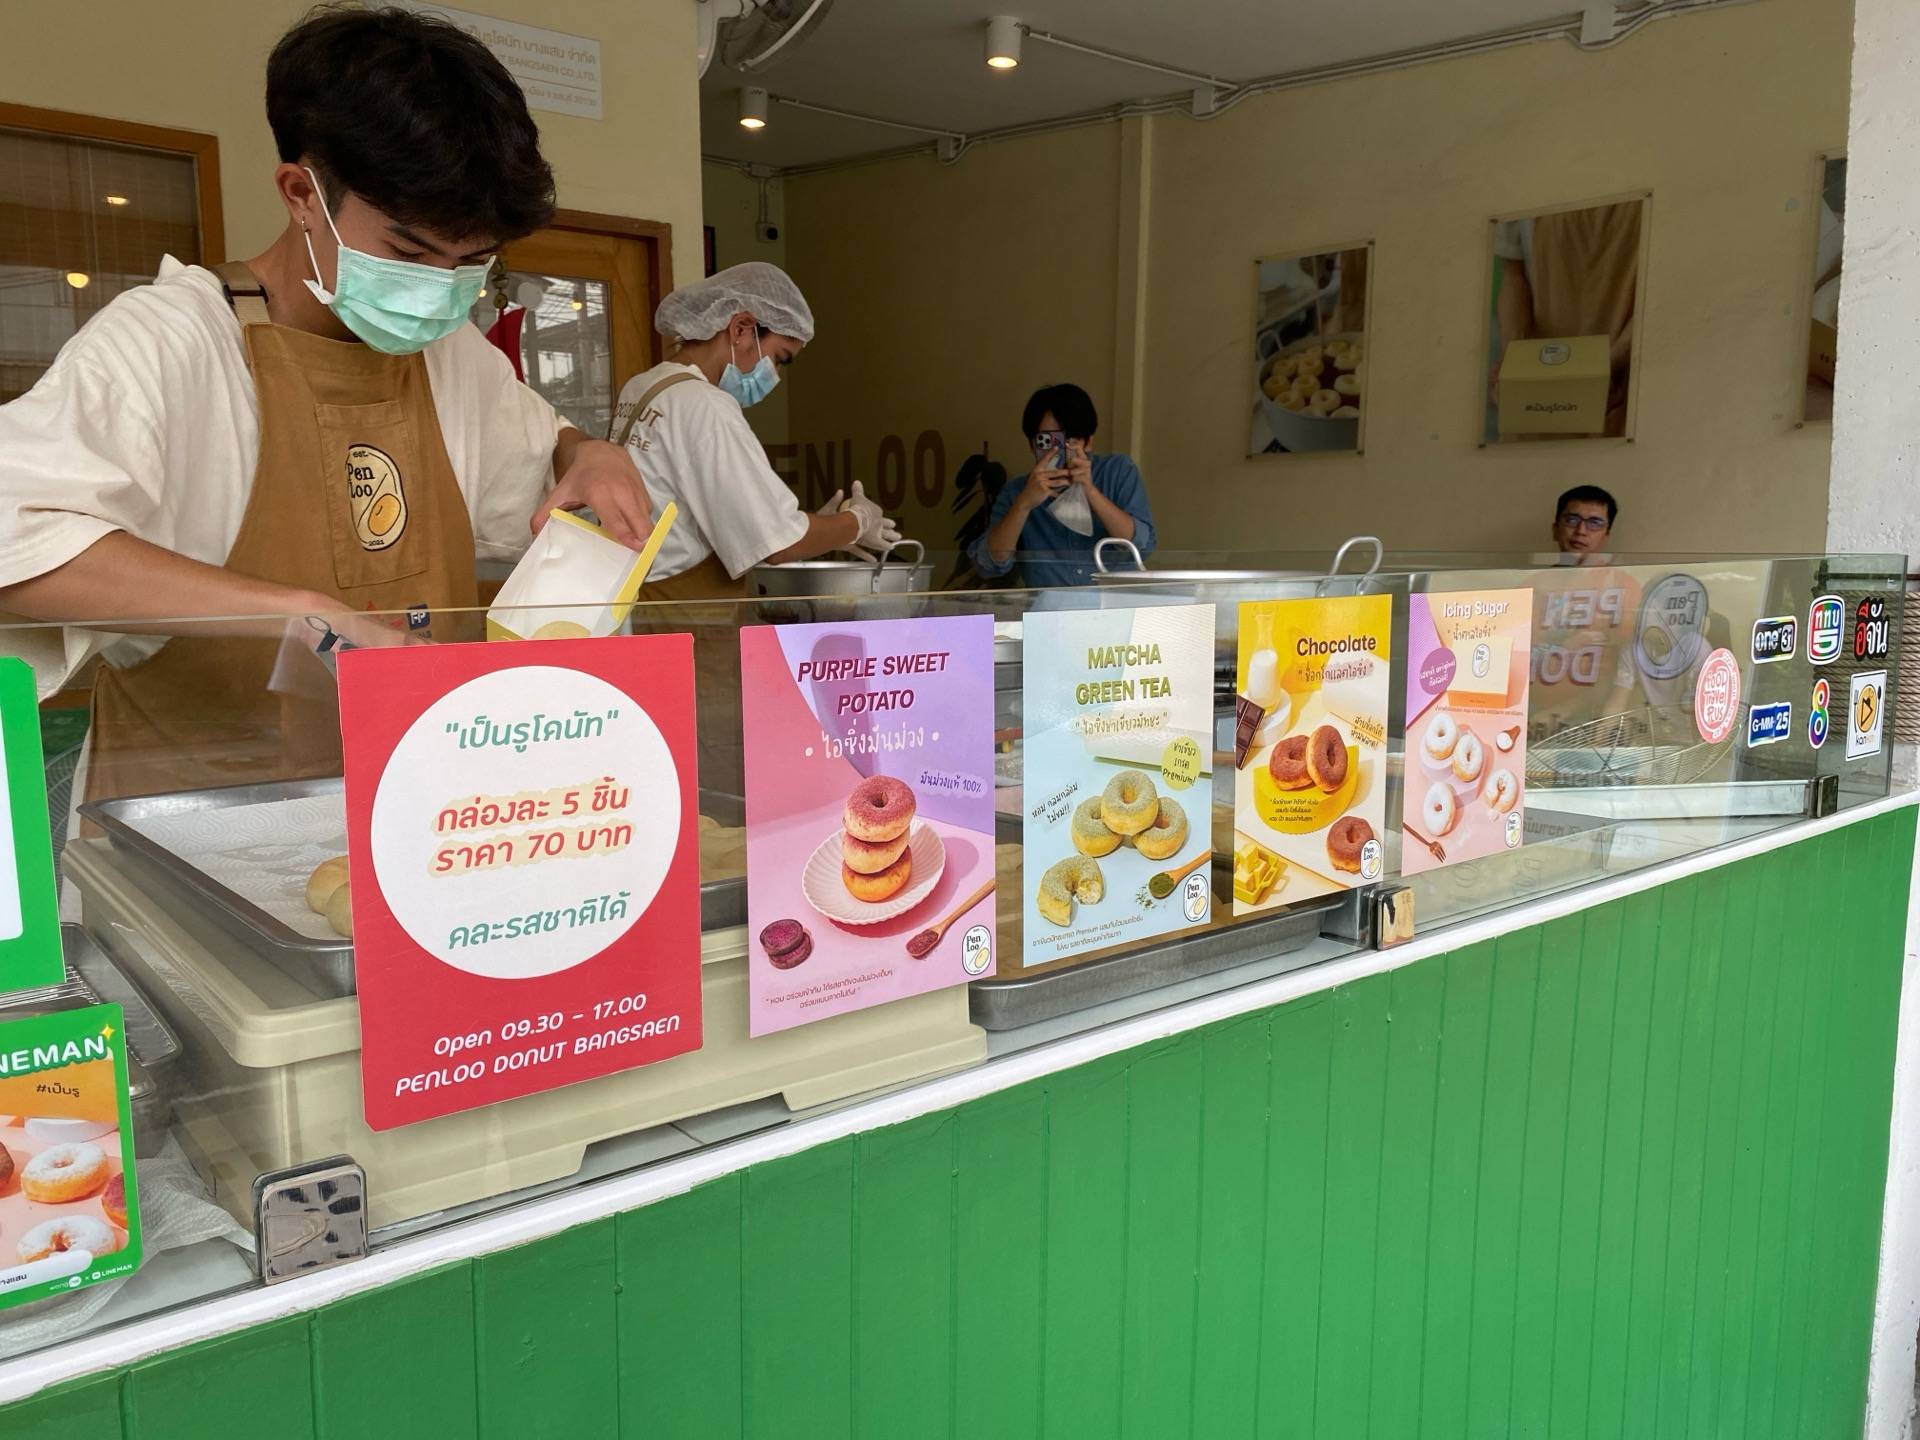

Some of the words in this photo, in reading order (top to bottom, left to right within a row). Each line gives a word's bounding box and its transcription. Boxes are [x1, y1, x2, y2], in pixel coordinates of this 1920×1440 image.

[347, 462, 375, 481] Pen
[1443, 602, 1472, 619] Icing
[1474, 599, 1509, 618] Sugar
[1296, 635, 1376, 656] Chocolate
[1754, 630, 1779, 652] one
[1781, 628, 1793, 649] 31
[1812, 628, 1839, 654] 5
[797, 657, 877, 682] PURPLE
[882, 652, 950, 676] SWEET
[1088, 644, 1162, 669] MATCHA
[837, 689, 915, 715] POTATO
[1075, 679, 1135, 705] GREEN
[1140, 676, 1172, 699] TEA
[1775, 711, 1789, 731] 25
[822, 719, 925, 759] ไอซิ่งมันม่วง
[963, 779, 982, 793] 100%
[437, 797, 550, 832] กล่องละ
[561, 792, 580, 816] 5
[591, 776, 629, 812] ชิ้น
[1031, 802, 1046, 819] หอม
[435, 841, 514, 873] ราคา
[527, 832, 565, 859] 70
[576, 823, 633, 851] บาท
[1187, 883, 1200, 893] Pen
[448, 891, 631, 950] คละรสชาติได้
[966, 935, 982, 944] Pen
[433, 1030, 492, 1058] Open
[501, 1012, 564, 1042] 09.30
[592, 993, 647, 1021] 17.00
[395, 1060, 486, 1097] PENLOO
[493, 1041, 567, 1075] DONUT
[574, 1015, 680, 1055] BANGSAEN
[36, 1082, 80, 1098] #เป็นรู
